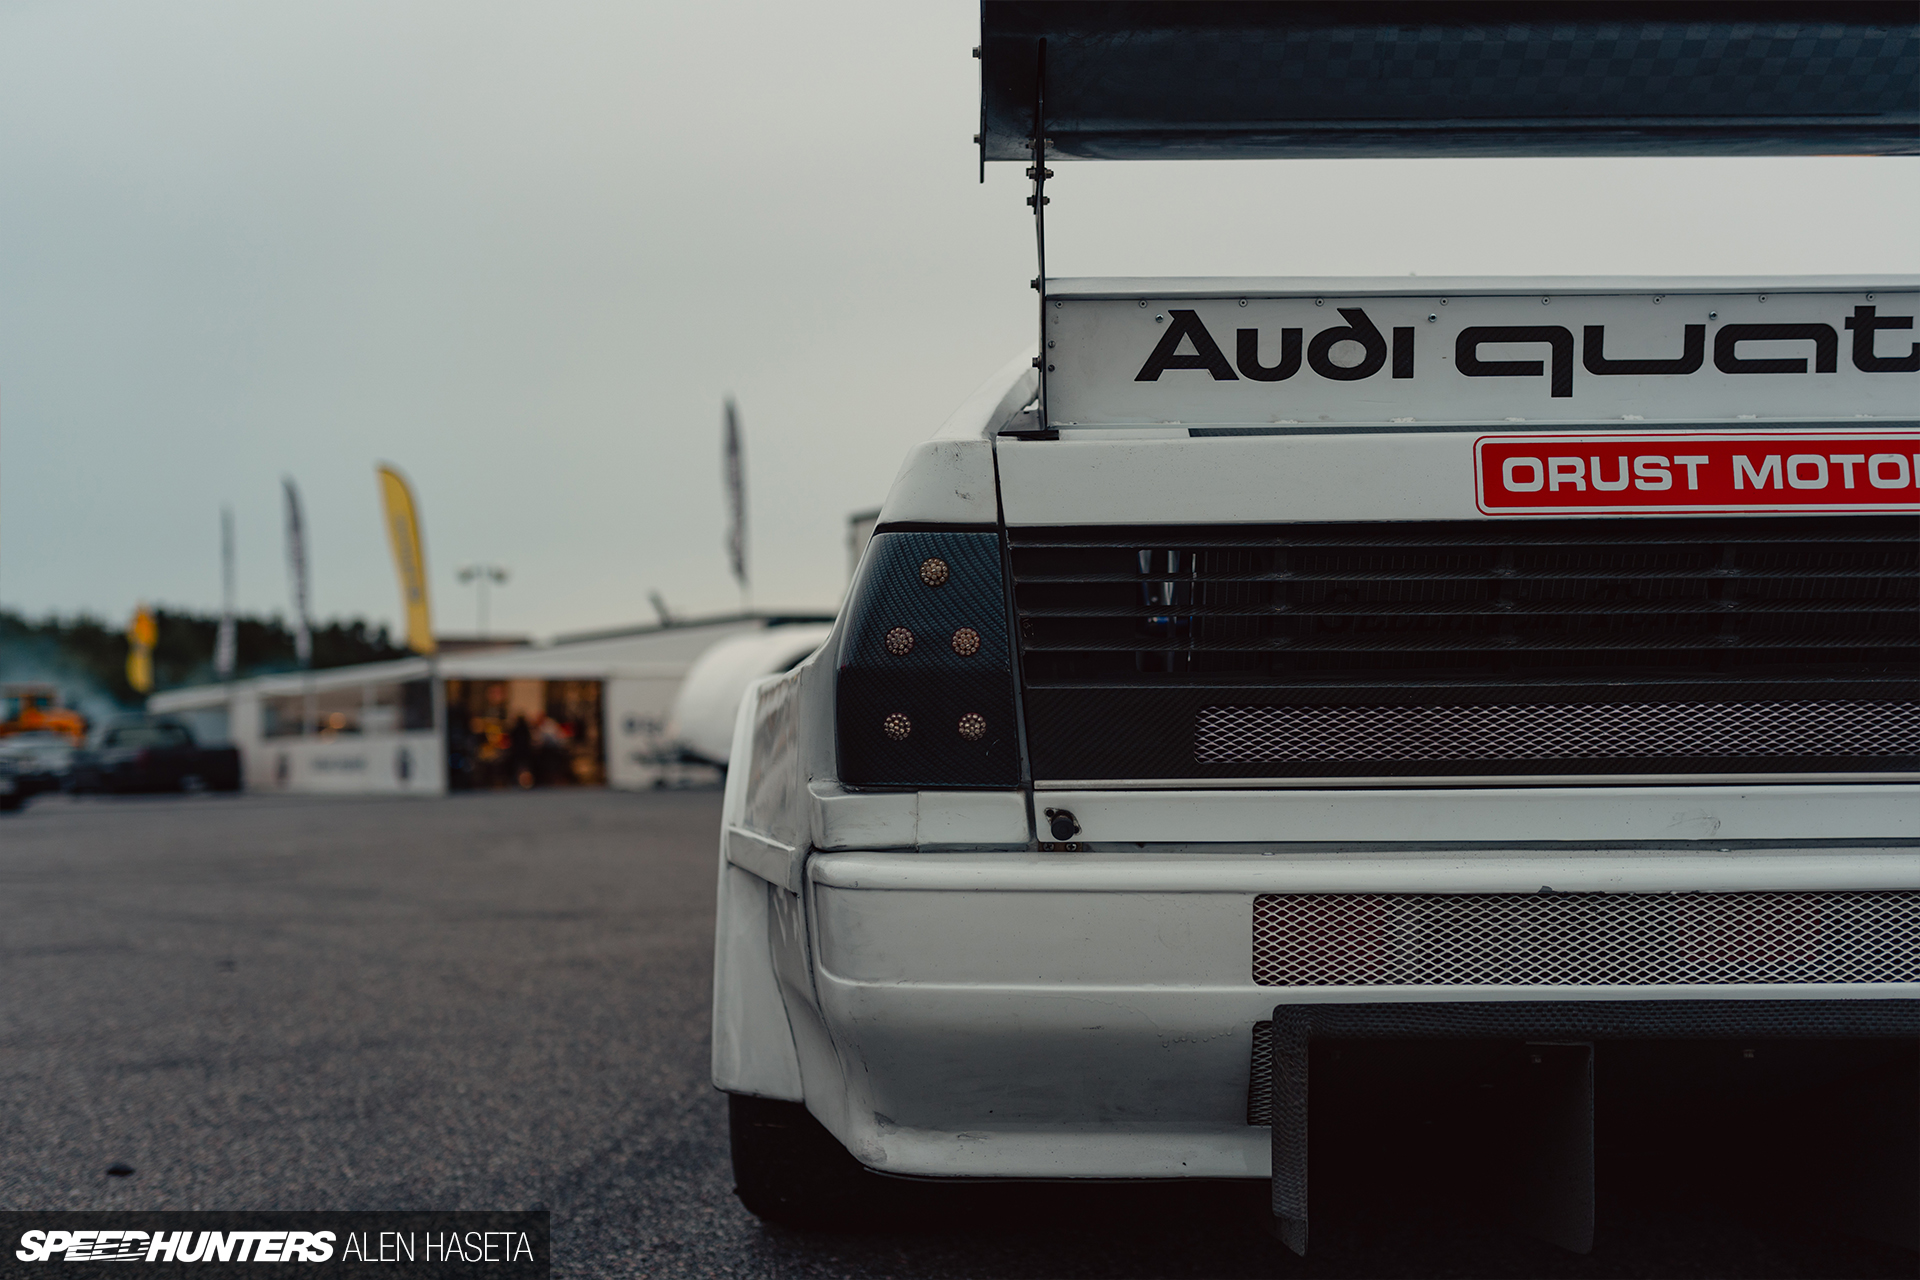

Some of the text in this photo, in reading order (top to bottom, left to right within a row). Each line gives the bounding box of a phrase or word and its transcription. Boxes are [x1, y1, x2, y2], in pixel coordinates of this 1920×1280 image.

[1133, 307, 1416, 382] Audi
[1502, 453, 1920, 493] ORUST MOTO
